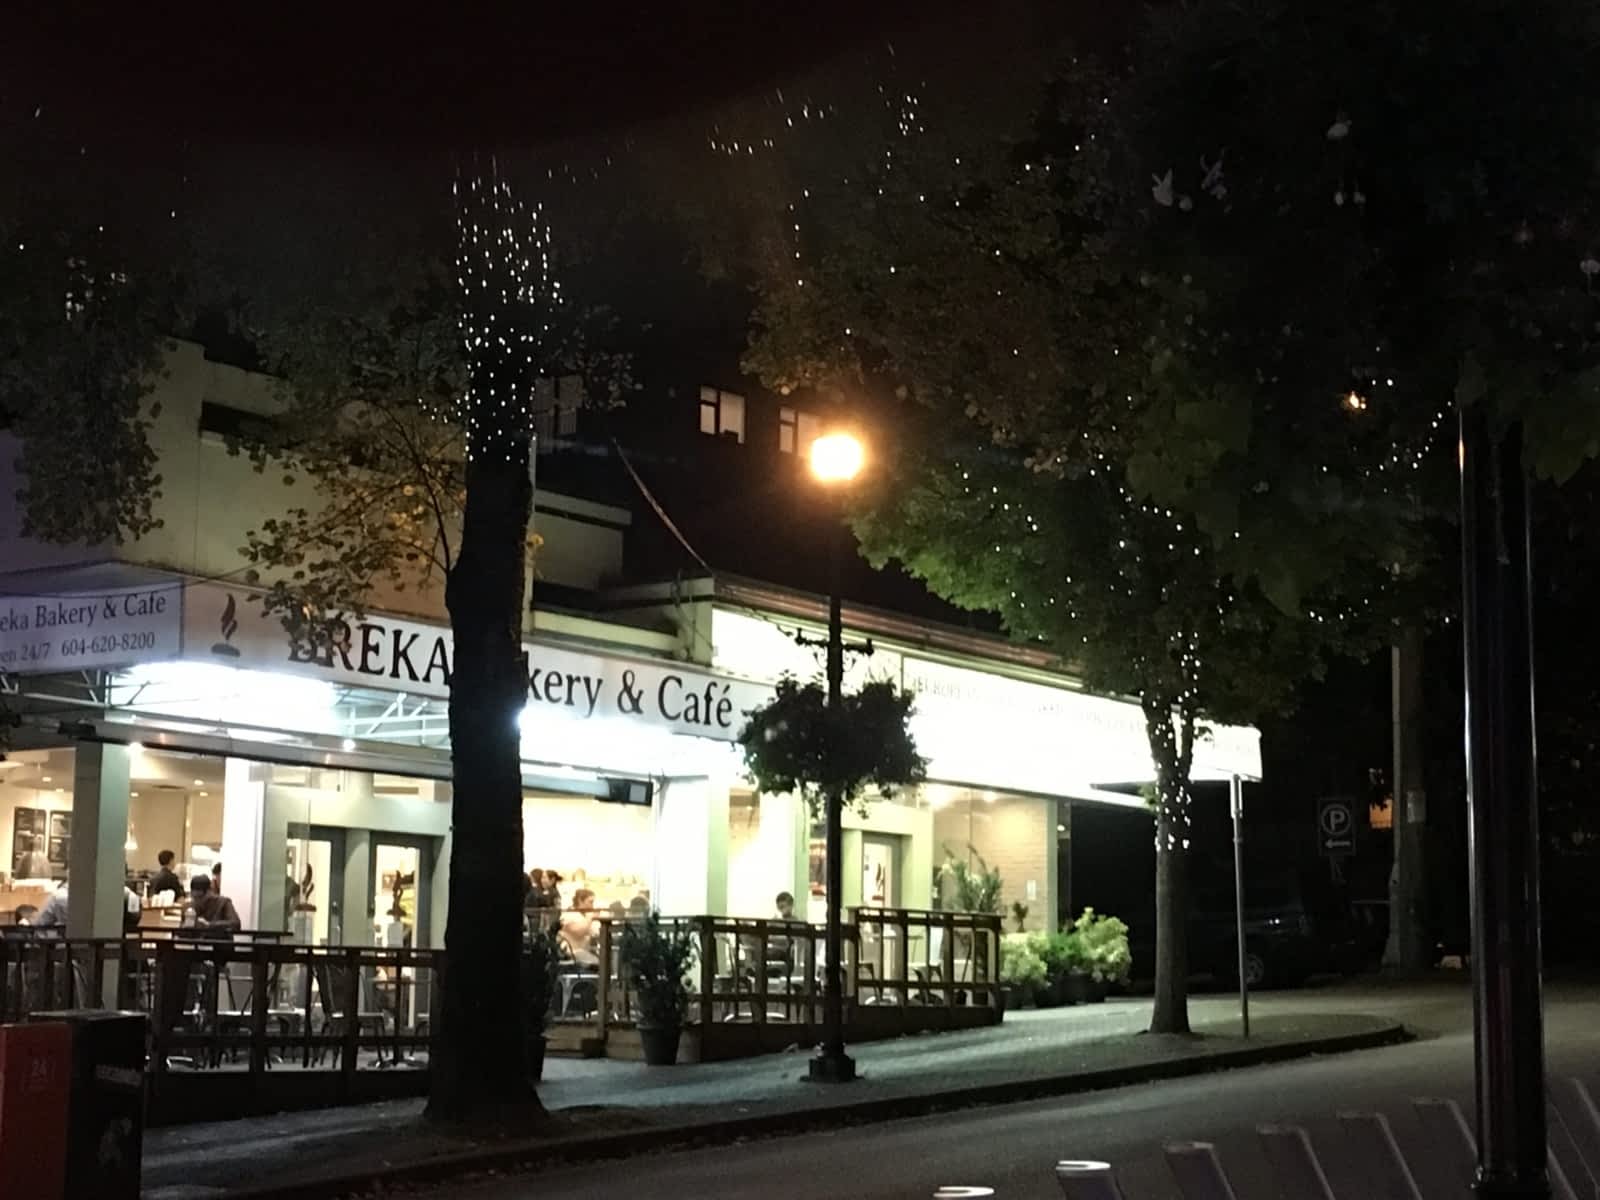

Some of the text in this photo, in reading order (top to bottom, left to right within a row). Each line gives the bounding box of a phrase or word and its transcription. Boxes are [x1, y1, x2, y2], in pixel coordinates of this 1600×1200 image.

[35, 601, 97, 627] Bakery
[103, 595, 116, 619] &
[21, 642, 51, 661] 24/7
[61, 631, 155, 657] 604-620-8200
[526, 660, 603, 718] kery
[617, 670, 644, 714] &
[658, 675, 733, 728] Café
[1329, 810, 1346, 832] P
